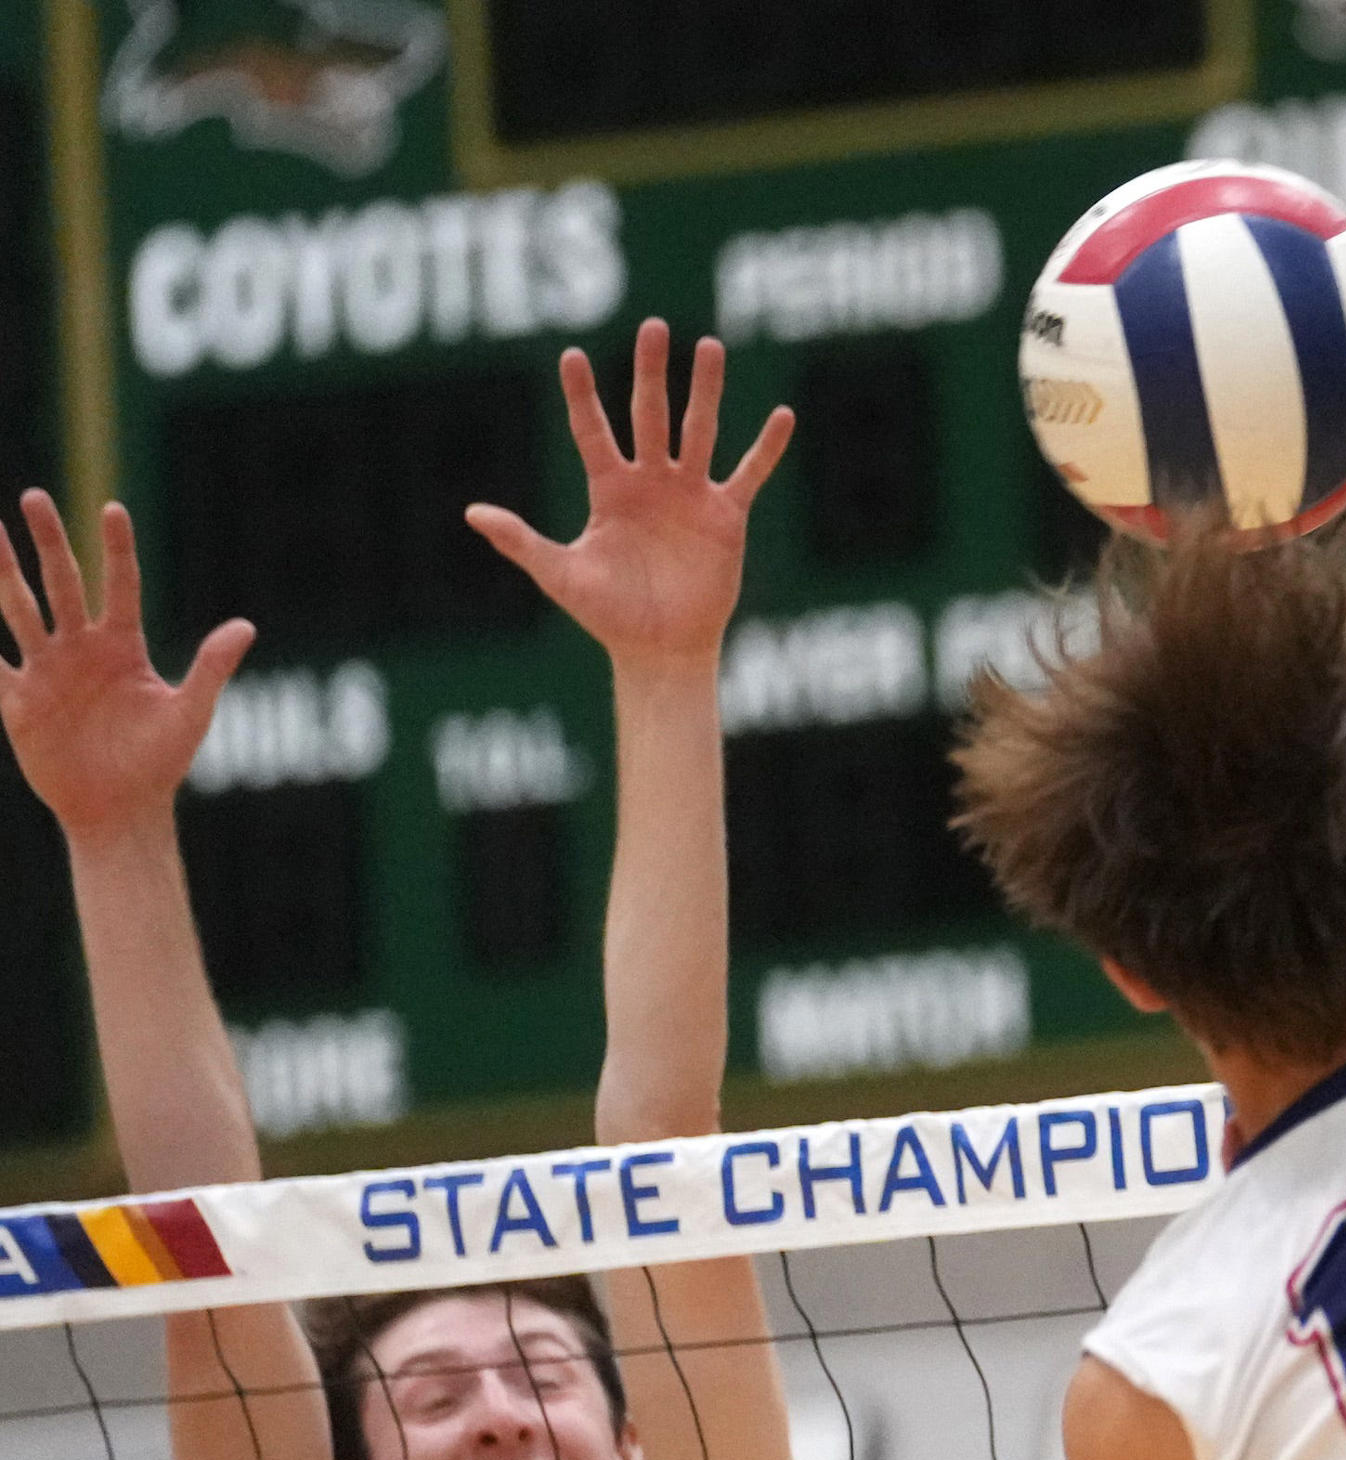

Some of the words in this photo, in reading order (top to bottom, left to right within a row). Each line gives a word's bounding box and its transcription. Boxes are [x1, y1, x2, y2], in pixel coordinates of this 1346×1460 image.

[130, 180, 626, 378] COYOTES
[714, 210, 1002, 346] PERIOD
[359, 1152, 682, 1264] STATE
[721, 1093, 1236, 1227] CHAMPIO
